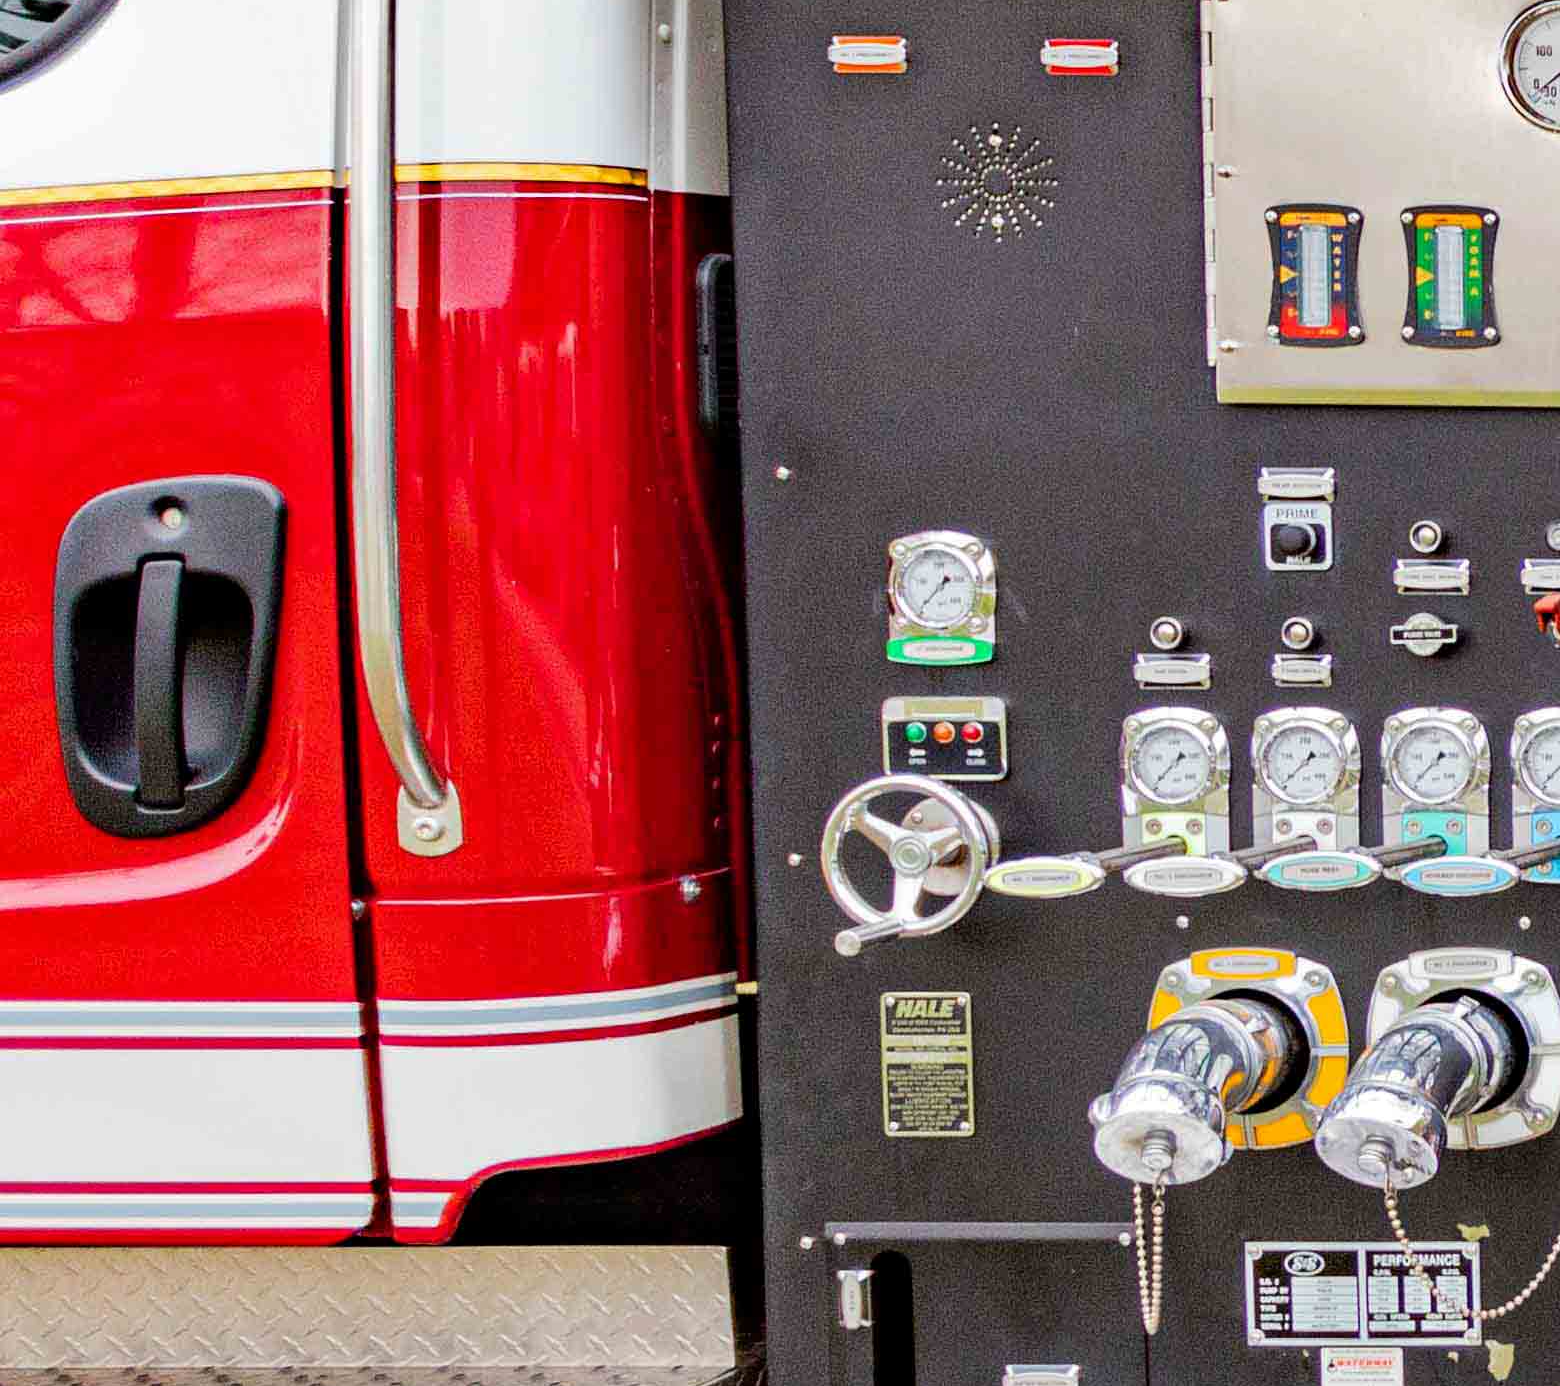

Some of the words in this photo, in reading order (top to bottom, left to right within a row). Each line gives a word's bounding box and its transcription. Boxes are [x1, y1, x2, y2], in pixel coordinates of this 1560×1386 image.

[1535, 45, 1553, 58] 100
[1331, 232, 1345, 292] WATER
[1275, 508, 1319, 519] PRIME
[895, 999, 957, 1019] HALE
